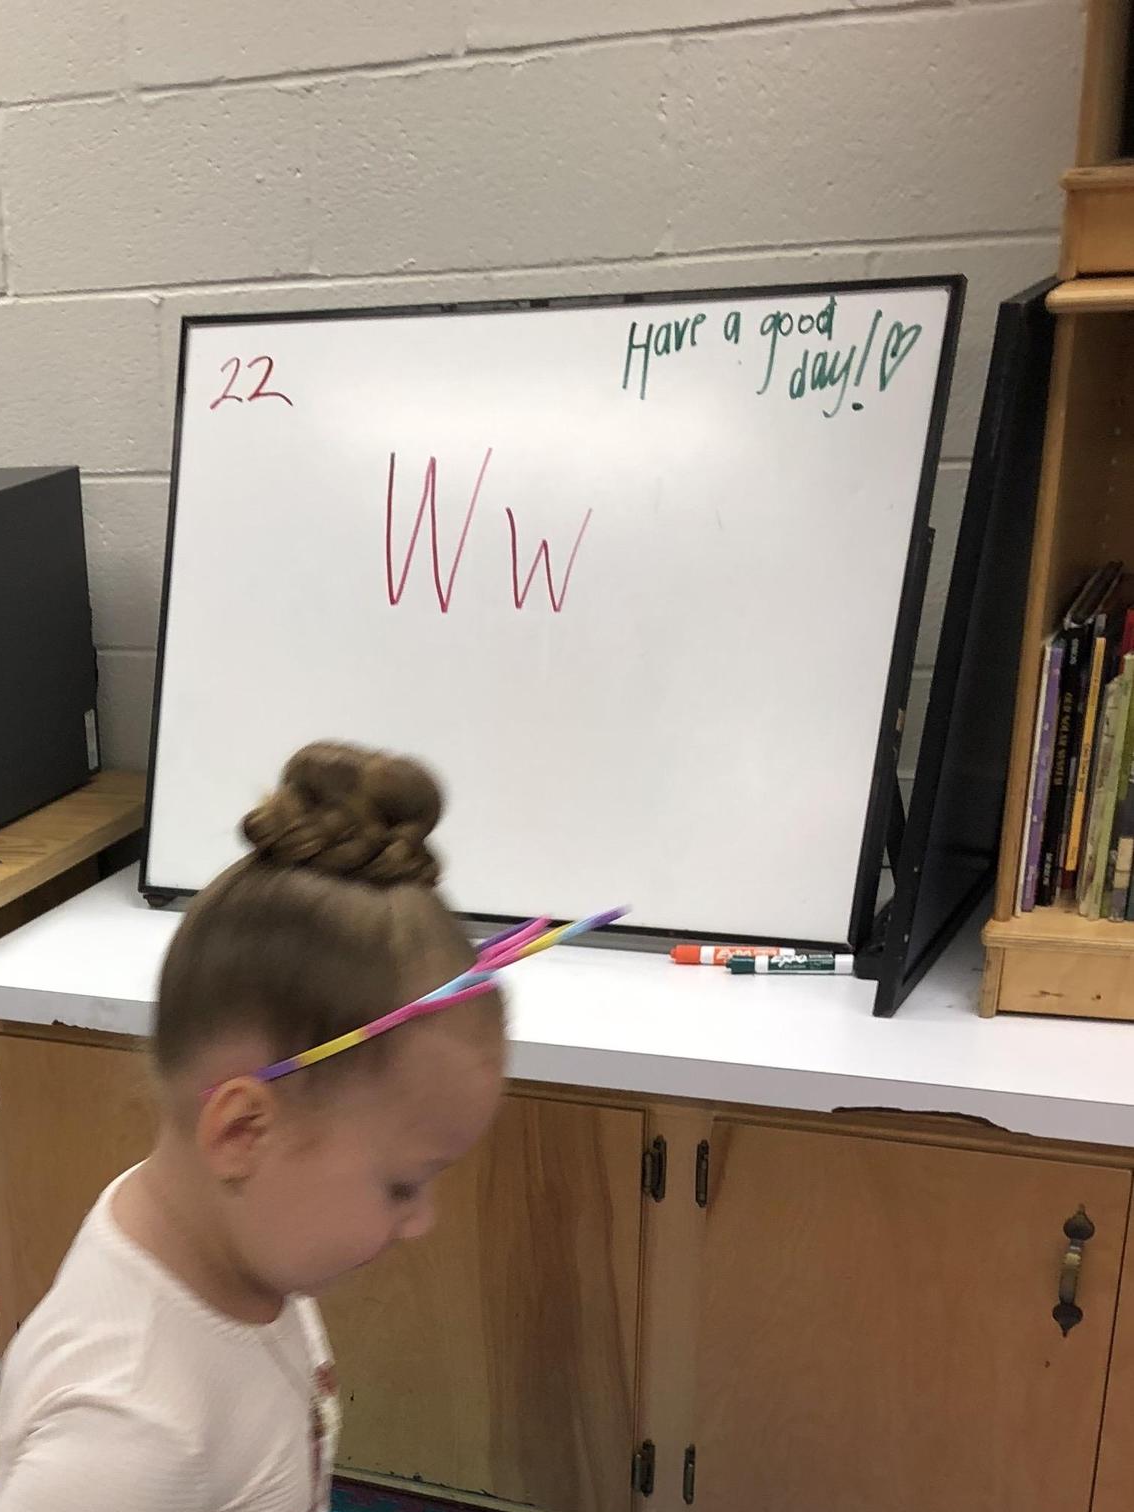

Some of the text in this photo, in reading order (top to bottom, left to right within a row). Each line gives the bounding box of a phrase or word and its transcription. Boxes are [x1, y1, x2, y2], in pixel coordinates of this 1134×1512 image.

[209, 355, 293, 409] 22
[622, 296, 838, 400] Have a good
[788, 310, 882, 418] day!
